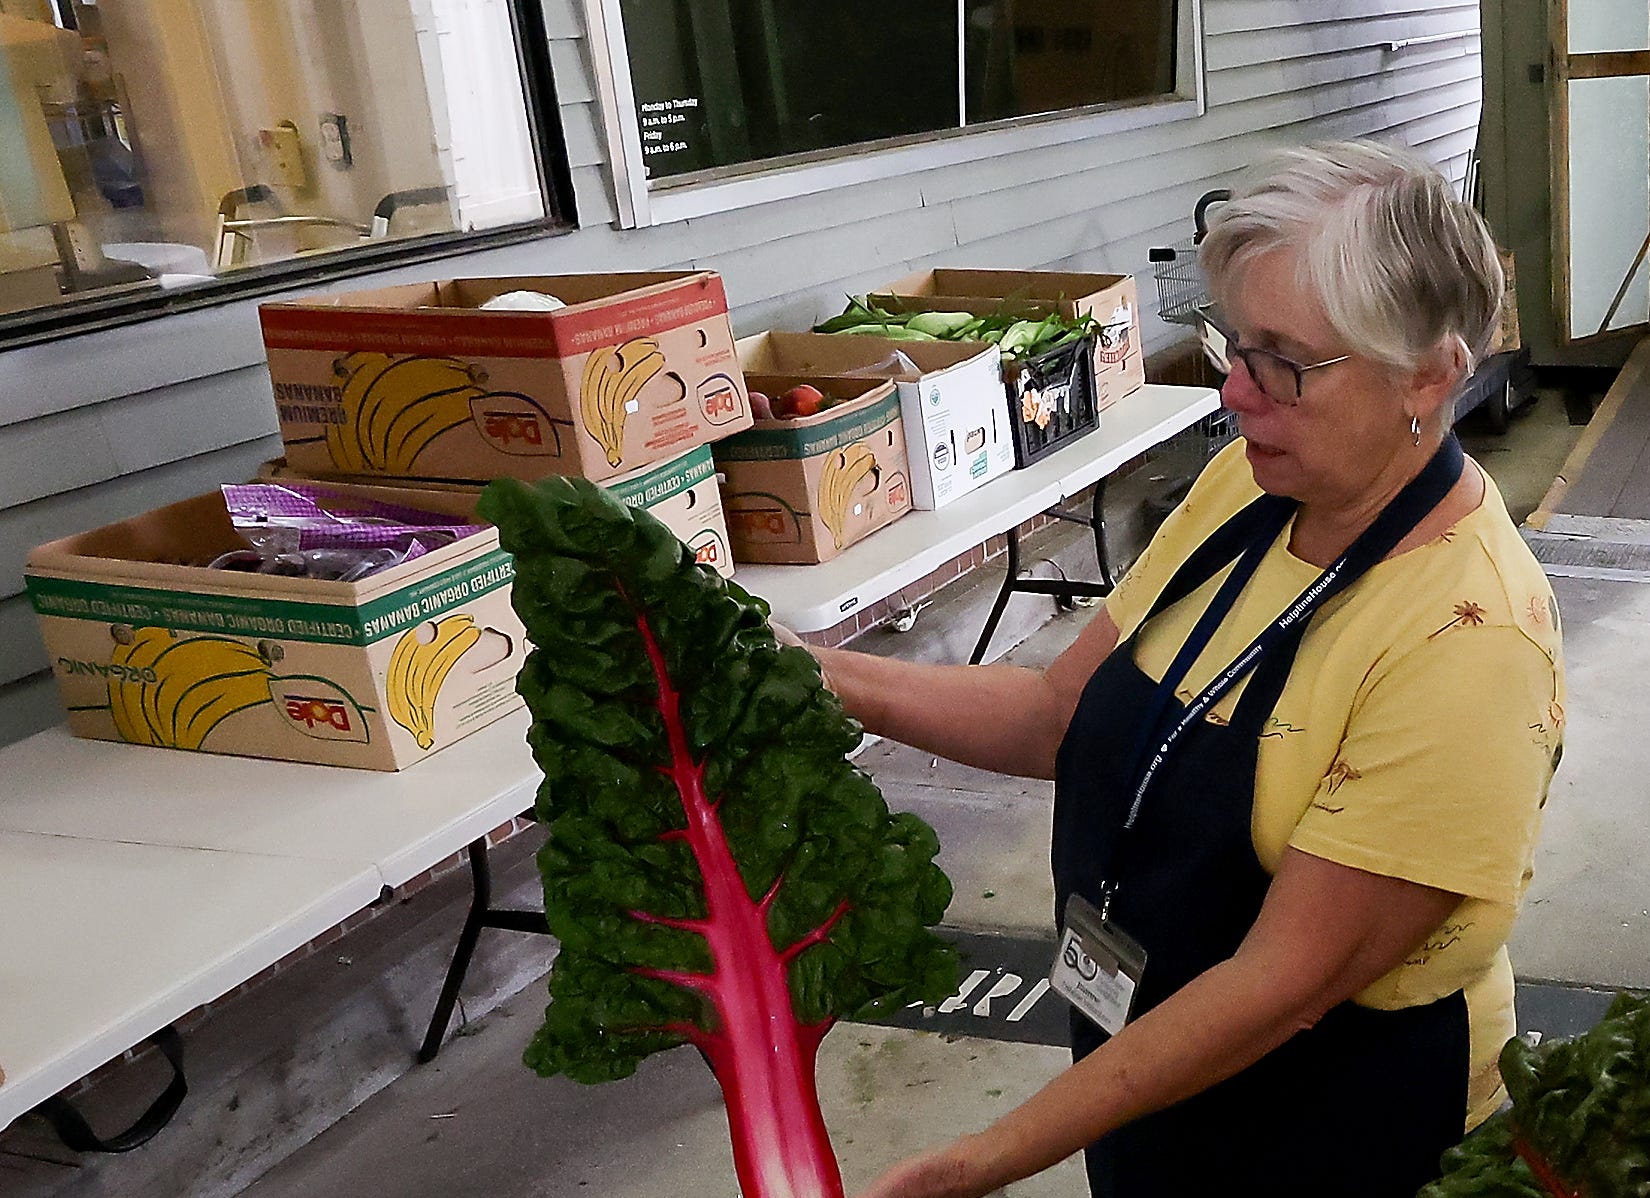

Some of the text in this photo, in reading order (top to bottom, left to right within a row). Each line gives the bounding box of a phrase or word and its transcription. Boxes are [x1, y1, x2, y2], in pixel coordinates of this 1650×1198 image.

[641, 98, 698, 112] Monday to Thursday
[642, 117, 647, 126] 9
[660, 115, 667, 124] to
[643, 131, 663, 140] Friday
[644, 146, 649, 155] 9
[662, 144, 669, 152] to
[275, 383, 343, 401] BANANAS
[279, 403, 348, 425] PREMIUM
[705, 391, 735, 418] Dole
[485, 416, 542, 446] Dole
[422, 581, 469, 614] ORGANIC
[164, 608, 224, 628] BANANAS
[226, 613, 284, 634] ORGANIC
[364, 601, 420, 637] BANANAS
[1226, 644, 1263, 678] Community
[1279, 557, 1347, 630] HelplineHouse
[288, 619, 353, 639] CERTIFIED
[58, 656, 158, 684] ORGANIC
[286, 699, 351, 732] Dole
